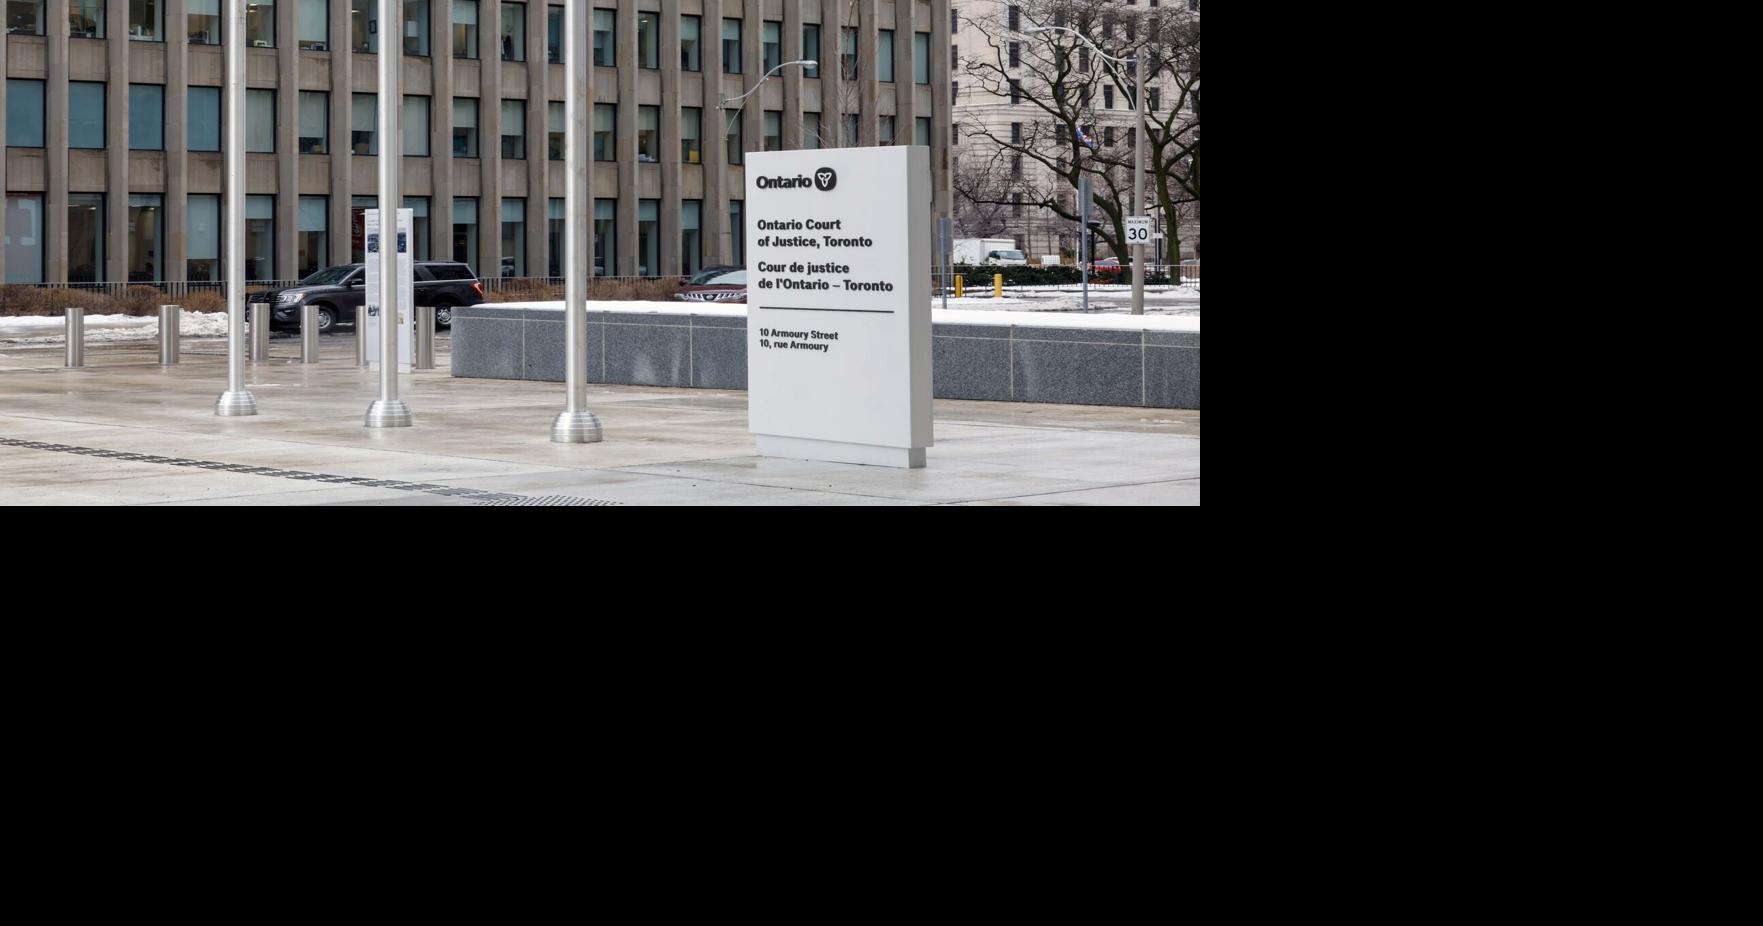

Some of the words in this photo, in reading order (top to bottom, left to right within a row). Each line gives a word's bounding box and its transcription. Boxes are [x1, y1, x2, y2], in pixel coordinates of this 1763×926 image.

[756, 174, 812, 189] Ontario
[757, 219, 802, 230] Ontario
[805, 218, 841, 230] Court
[1128, 228, 1147, 240] 30
[757, 236, 770, 247] of
[772, 236, 820, 249] Justice,
[823, 236, 873, 247] Toronto
[758, 261, 786, 273] Cour
[789, 261, 804, 273] de
[807, 262, 850, 275] justice
[758, 278, 773, 289] de
[776, 278, 829, 290] l'Ontario
[843, 280, 893, 291] Toronto
[760, 328, 769, 337] 10
[771, 328, 809, 340] Armoury
[811, 330, 839, 340] Street
[760, 339, 772, 349] 10,
[773, 341, 788, 349] rue
[790, 340, 829, 352] Armoury
